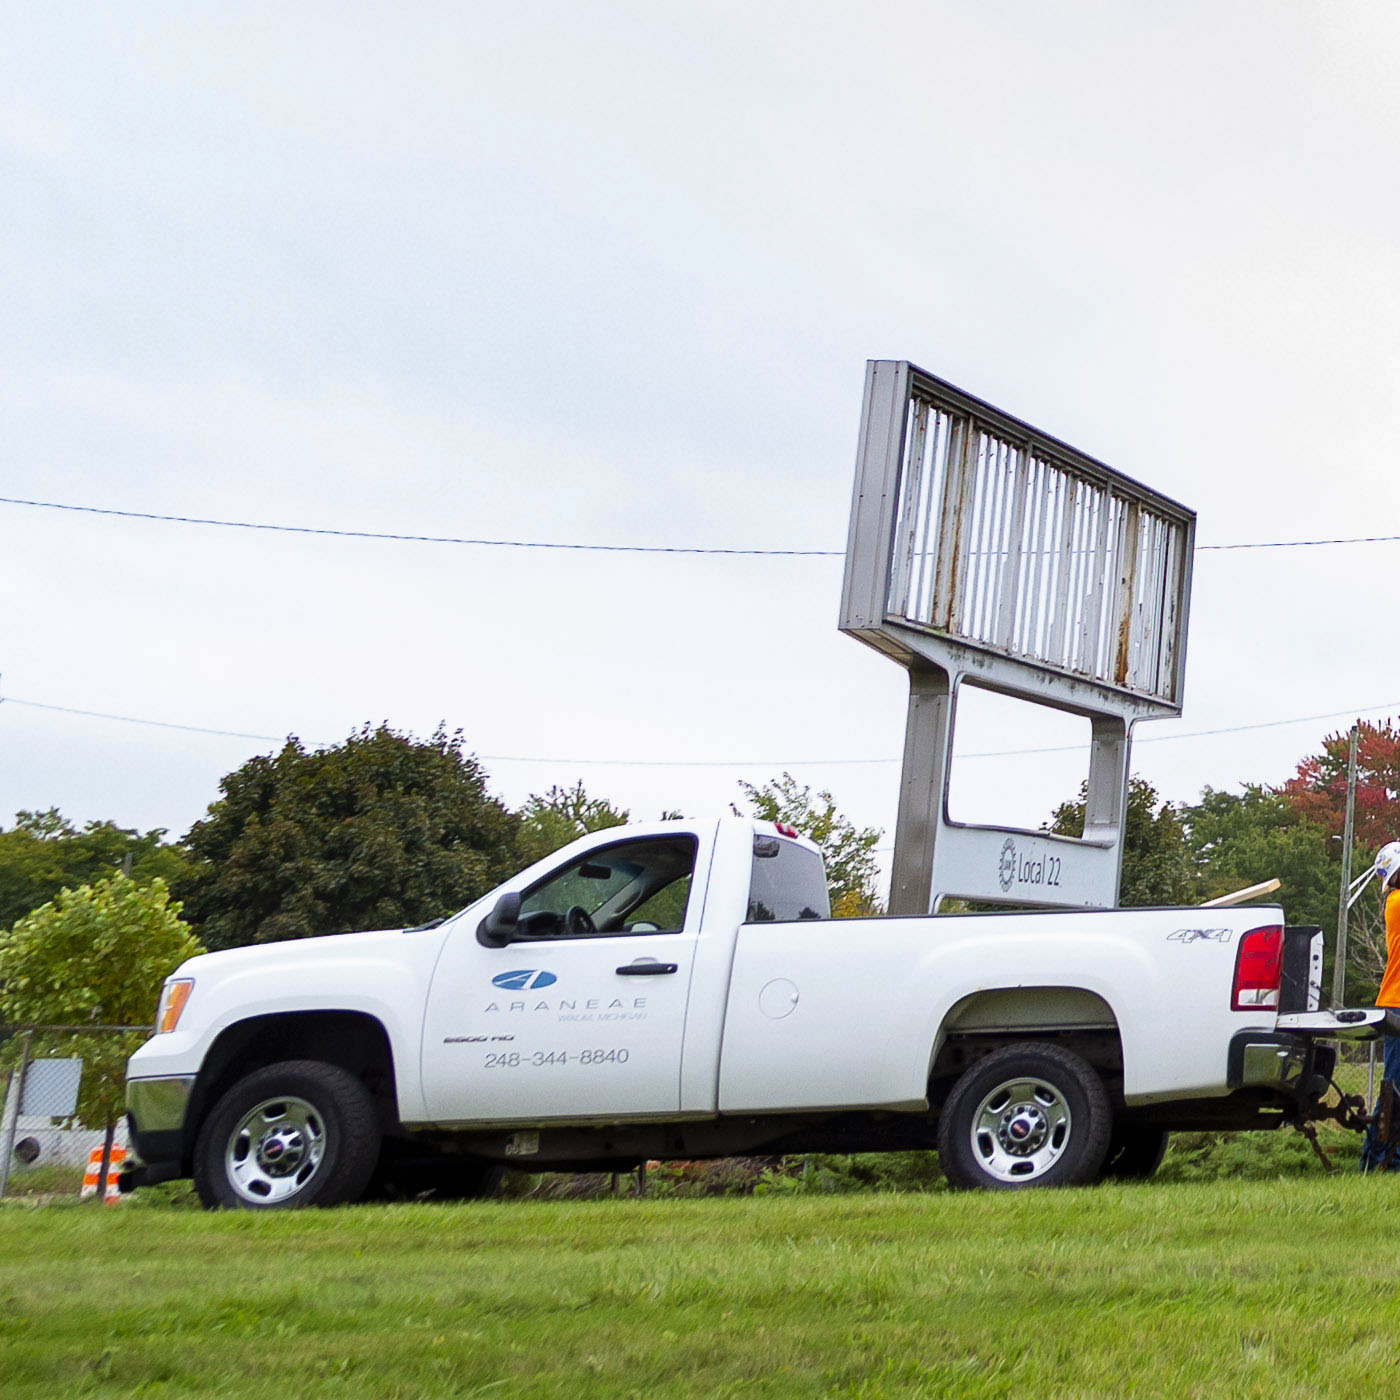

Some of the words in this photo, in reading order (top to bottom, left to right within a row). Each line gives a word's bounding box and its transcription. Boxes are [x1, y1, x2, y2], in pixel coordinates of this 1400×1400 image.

[1018, 852, 1046, 884] Local
[1047, 856, 1061, 886] 22
[484, 997, 648, 1013] ARANEAE
[484, 1048, 630, 1069] 248-344-8840
